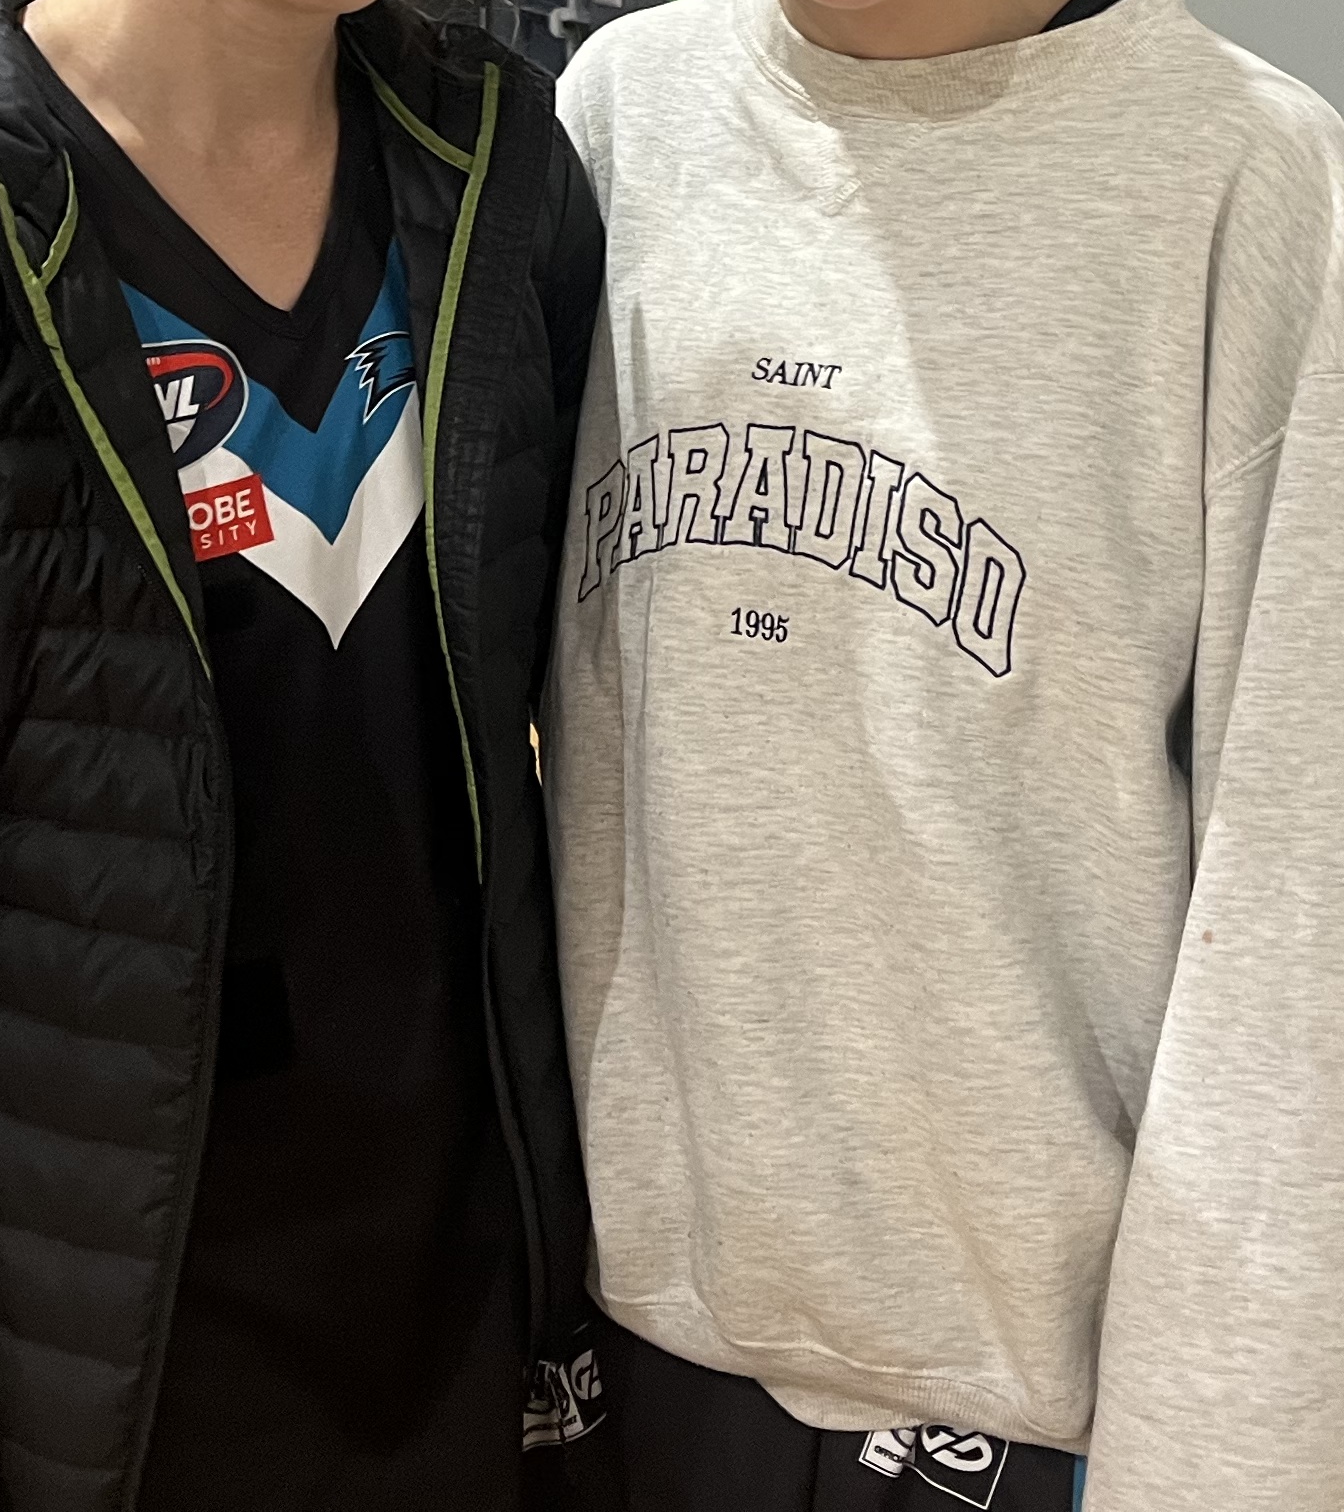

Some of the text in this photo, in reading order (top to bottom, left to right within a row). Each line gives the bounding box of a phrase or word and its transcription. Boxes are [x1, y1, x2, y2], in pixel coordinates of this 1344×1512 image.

[751, 357, 842, 389] SAINT
[187, 488, 256, 531] OBE
[200, 519, 257, 549] SITY
[577, 422, 1027, 678] PARADISO
[731, 607, 790, 643] 1995
